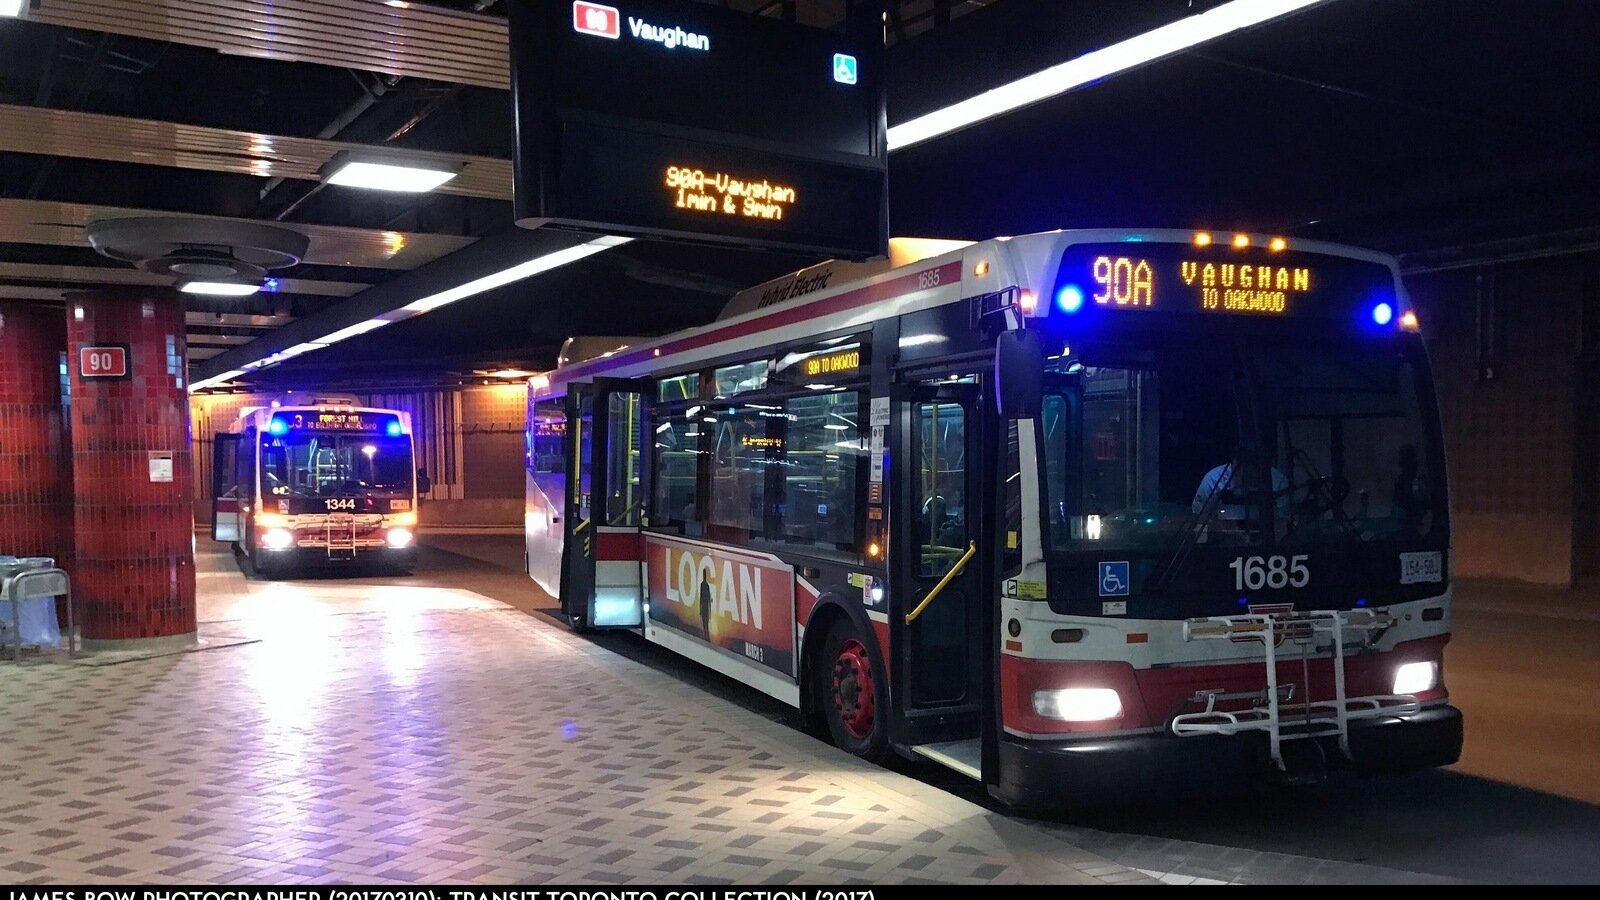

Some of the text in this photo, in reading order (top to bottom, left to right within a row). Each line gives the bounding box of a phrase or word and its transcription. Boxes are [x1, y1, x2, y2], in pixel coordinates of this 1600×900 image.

[628, 16, 709, 51] Vaughan
[676, 188, 782, 220] 1min & 9min
[757, 268, 833, 309] Hybrid Electric
[917, 268, 940, 290] 1685
[1093, 256, 1309, 306] 90A VAUGHAN
[1202, 288, 1285, 312] TO OAKWOOD
[90, 352, 112, 371] 90
[808, 359, 820, 375] 90A
[821, 357, 830, 373] TO
[319, 414, 347, 423] FOREST
[324, 498, 356, 510] 1344
[1229, 554, 1310, 591] 1685
[665, 547, 762, 630] LOGAN
